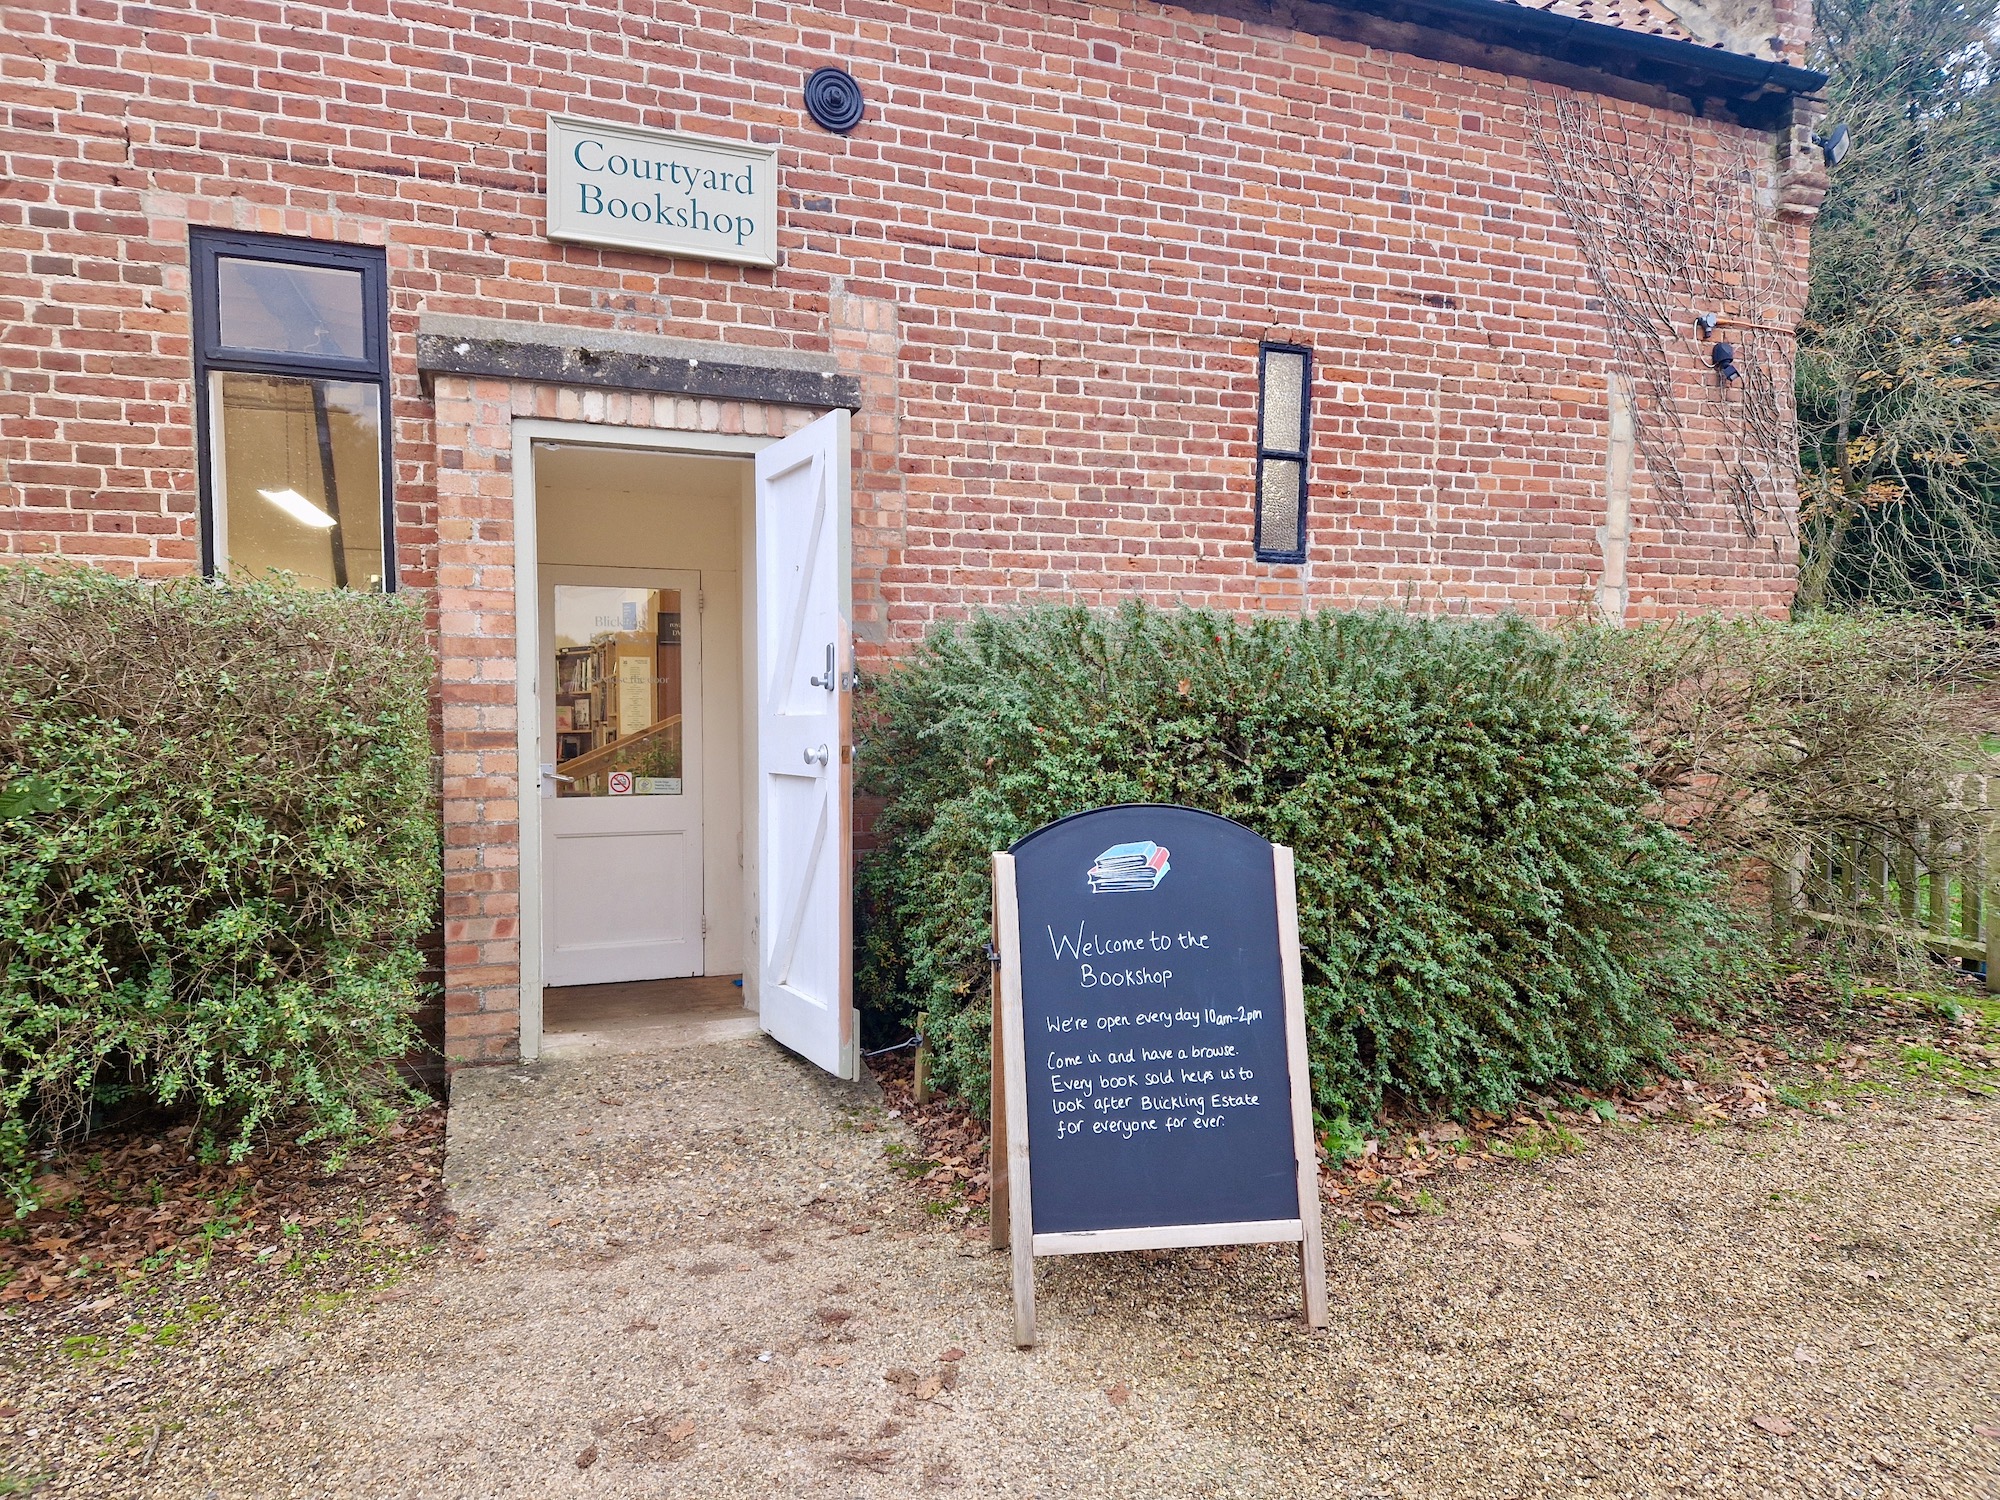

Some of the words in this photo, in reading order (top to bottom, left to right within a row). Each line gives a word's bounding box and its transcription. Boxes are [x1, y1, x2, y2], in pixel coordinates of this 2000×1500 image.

[574, 140, 754, 195] Courtyard
[576, 182, 754, 246] Bookshop
[1048, 920, 1144, 960] Welcome
[1149, 931, 1171, 951] to
[1178, 931, 1209, 949] the
[1081, 964, 1172, 987] Bookshop
[1047, 1016, 1087, 1032] We're
[1097, 1016, 1130, 1032] open
[1136, 1012, 1172, 1028] every
[1175, 1008, 1199, 1027] day
[1205, 1006, 1262, 1025] 10am-2pm
[1048, 1052, 1082, 1069] Come
[1088, 1050, 1101, 1063] in
[1108, 1049, 1135, 1063] and
[1142, 1048, 1173, 1061] have
[1178, 1050, 1188, 1059] a
[1192, 1046, 1238, 1058] browse.
[1052, 1075, 1092, 1097] Every
[1100, 1075, 1138, 1088] book
[1145, 1069, 1174, 1085] sold
[1181, 1069, 1213, 1084] helps
[1221, 1069, 1235, 1079] us
[1239, 1067, 1253, 1080] to
[1053, 1097, 1086, 1114] look
[1094, 1097, 1132, 1113] after
[1141, 1093, 1204, 1115] Blickling
[1212, 1094, 1259, 1107] Estate
[1058, 1120, 1084, 1139] for
[1093, 1120, 1157, 1139] everyone
[1165, 1117, 1187, 1132] for
[1193, 1113, 1224, 1128] ever.
